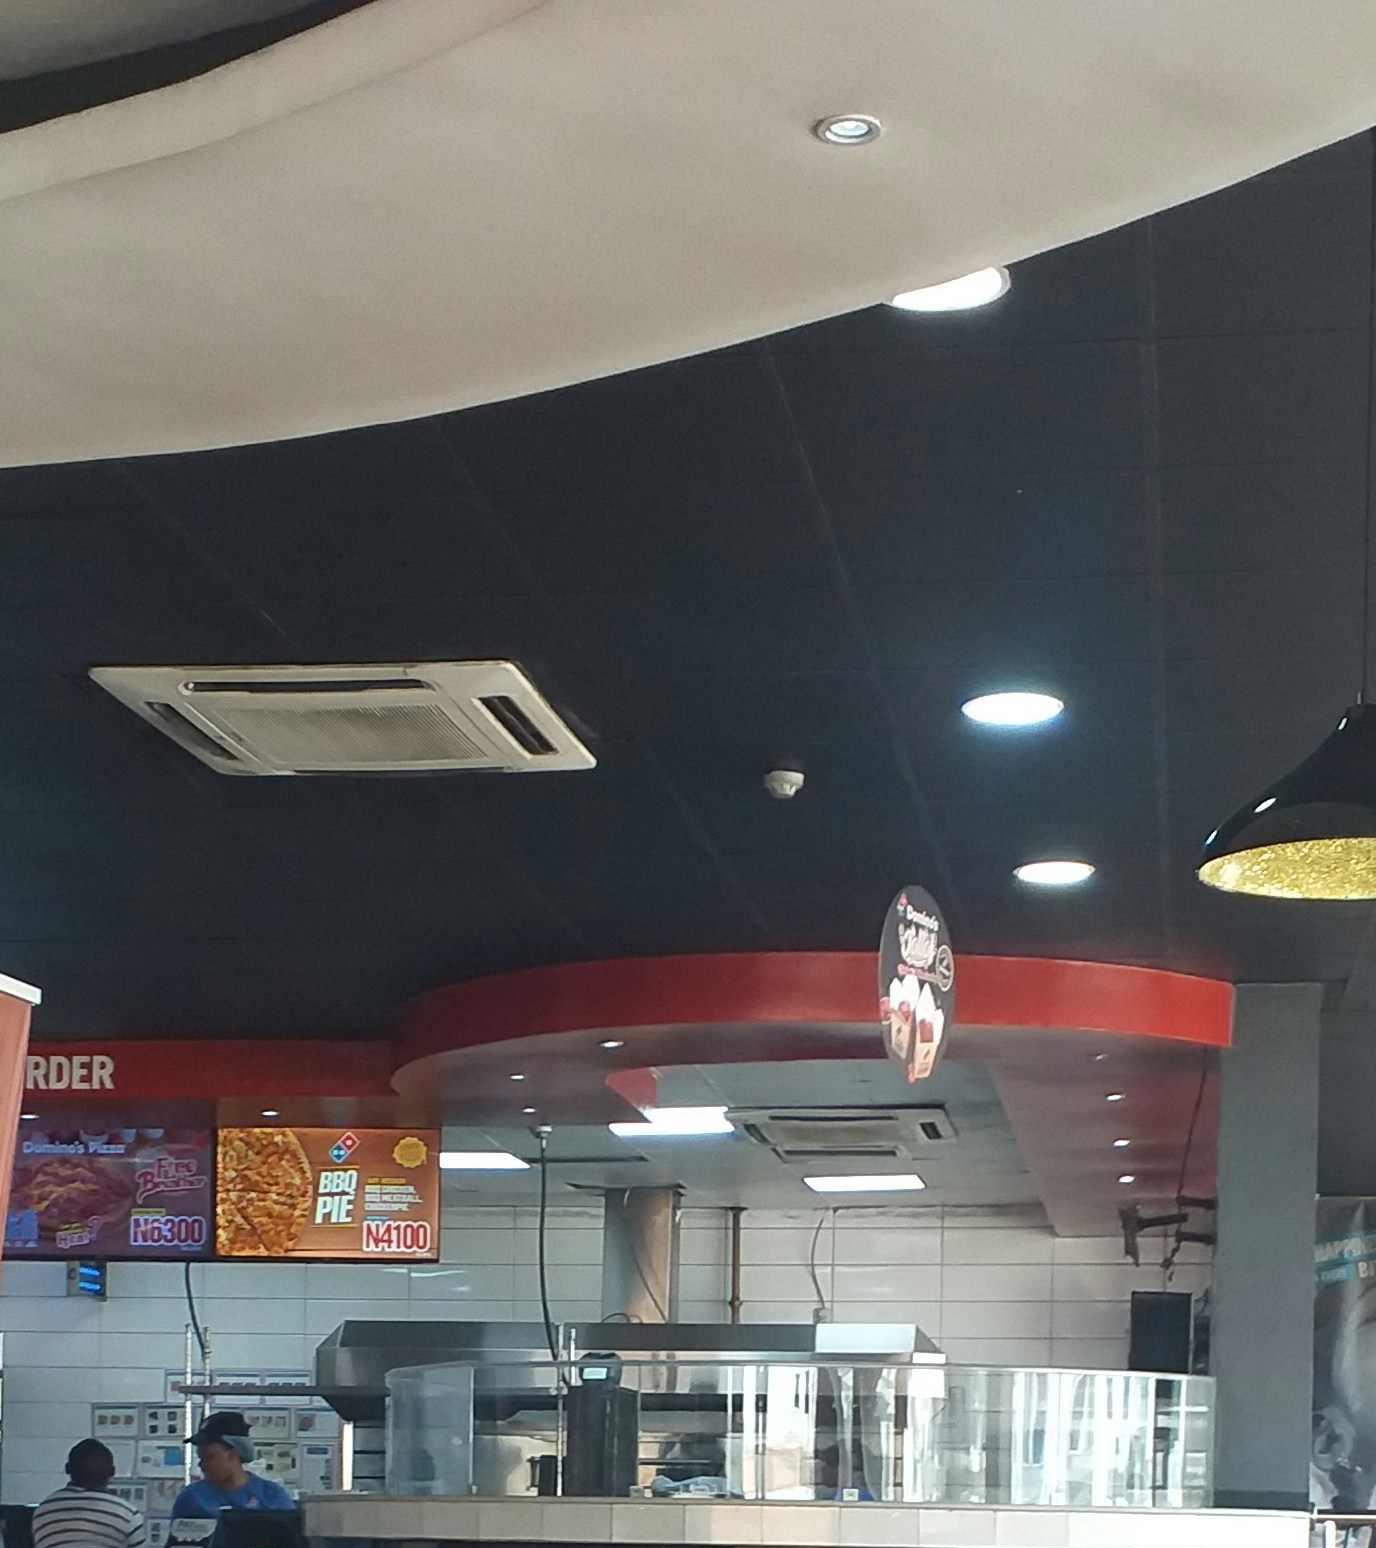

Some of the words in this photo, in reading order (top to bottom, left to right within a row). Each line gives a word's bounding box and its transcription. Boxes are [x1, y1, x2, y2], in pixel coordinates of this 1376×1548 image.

[26, 1056, 114, 1090] RDER
[318, 1169, 358, 1195] BBQ
[314, 1195, 355, 1225] PIE
